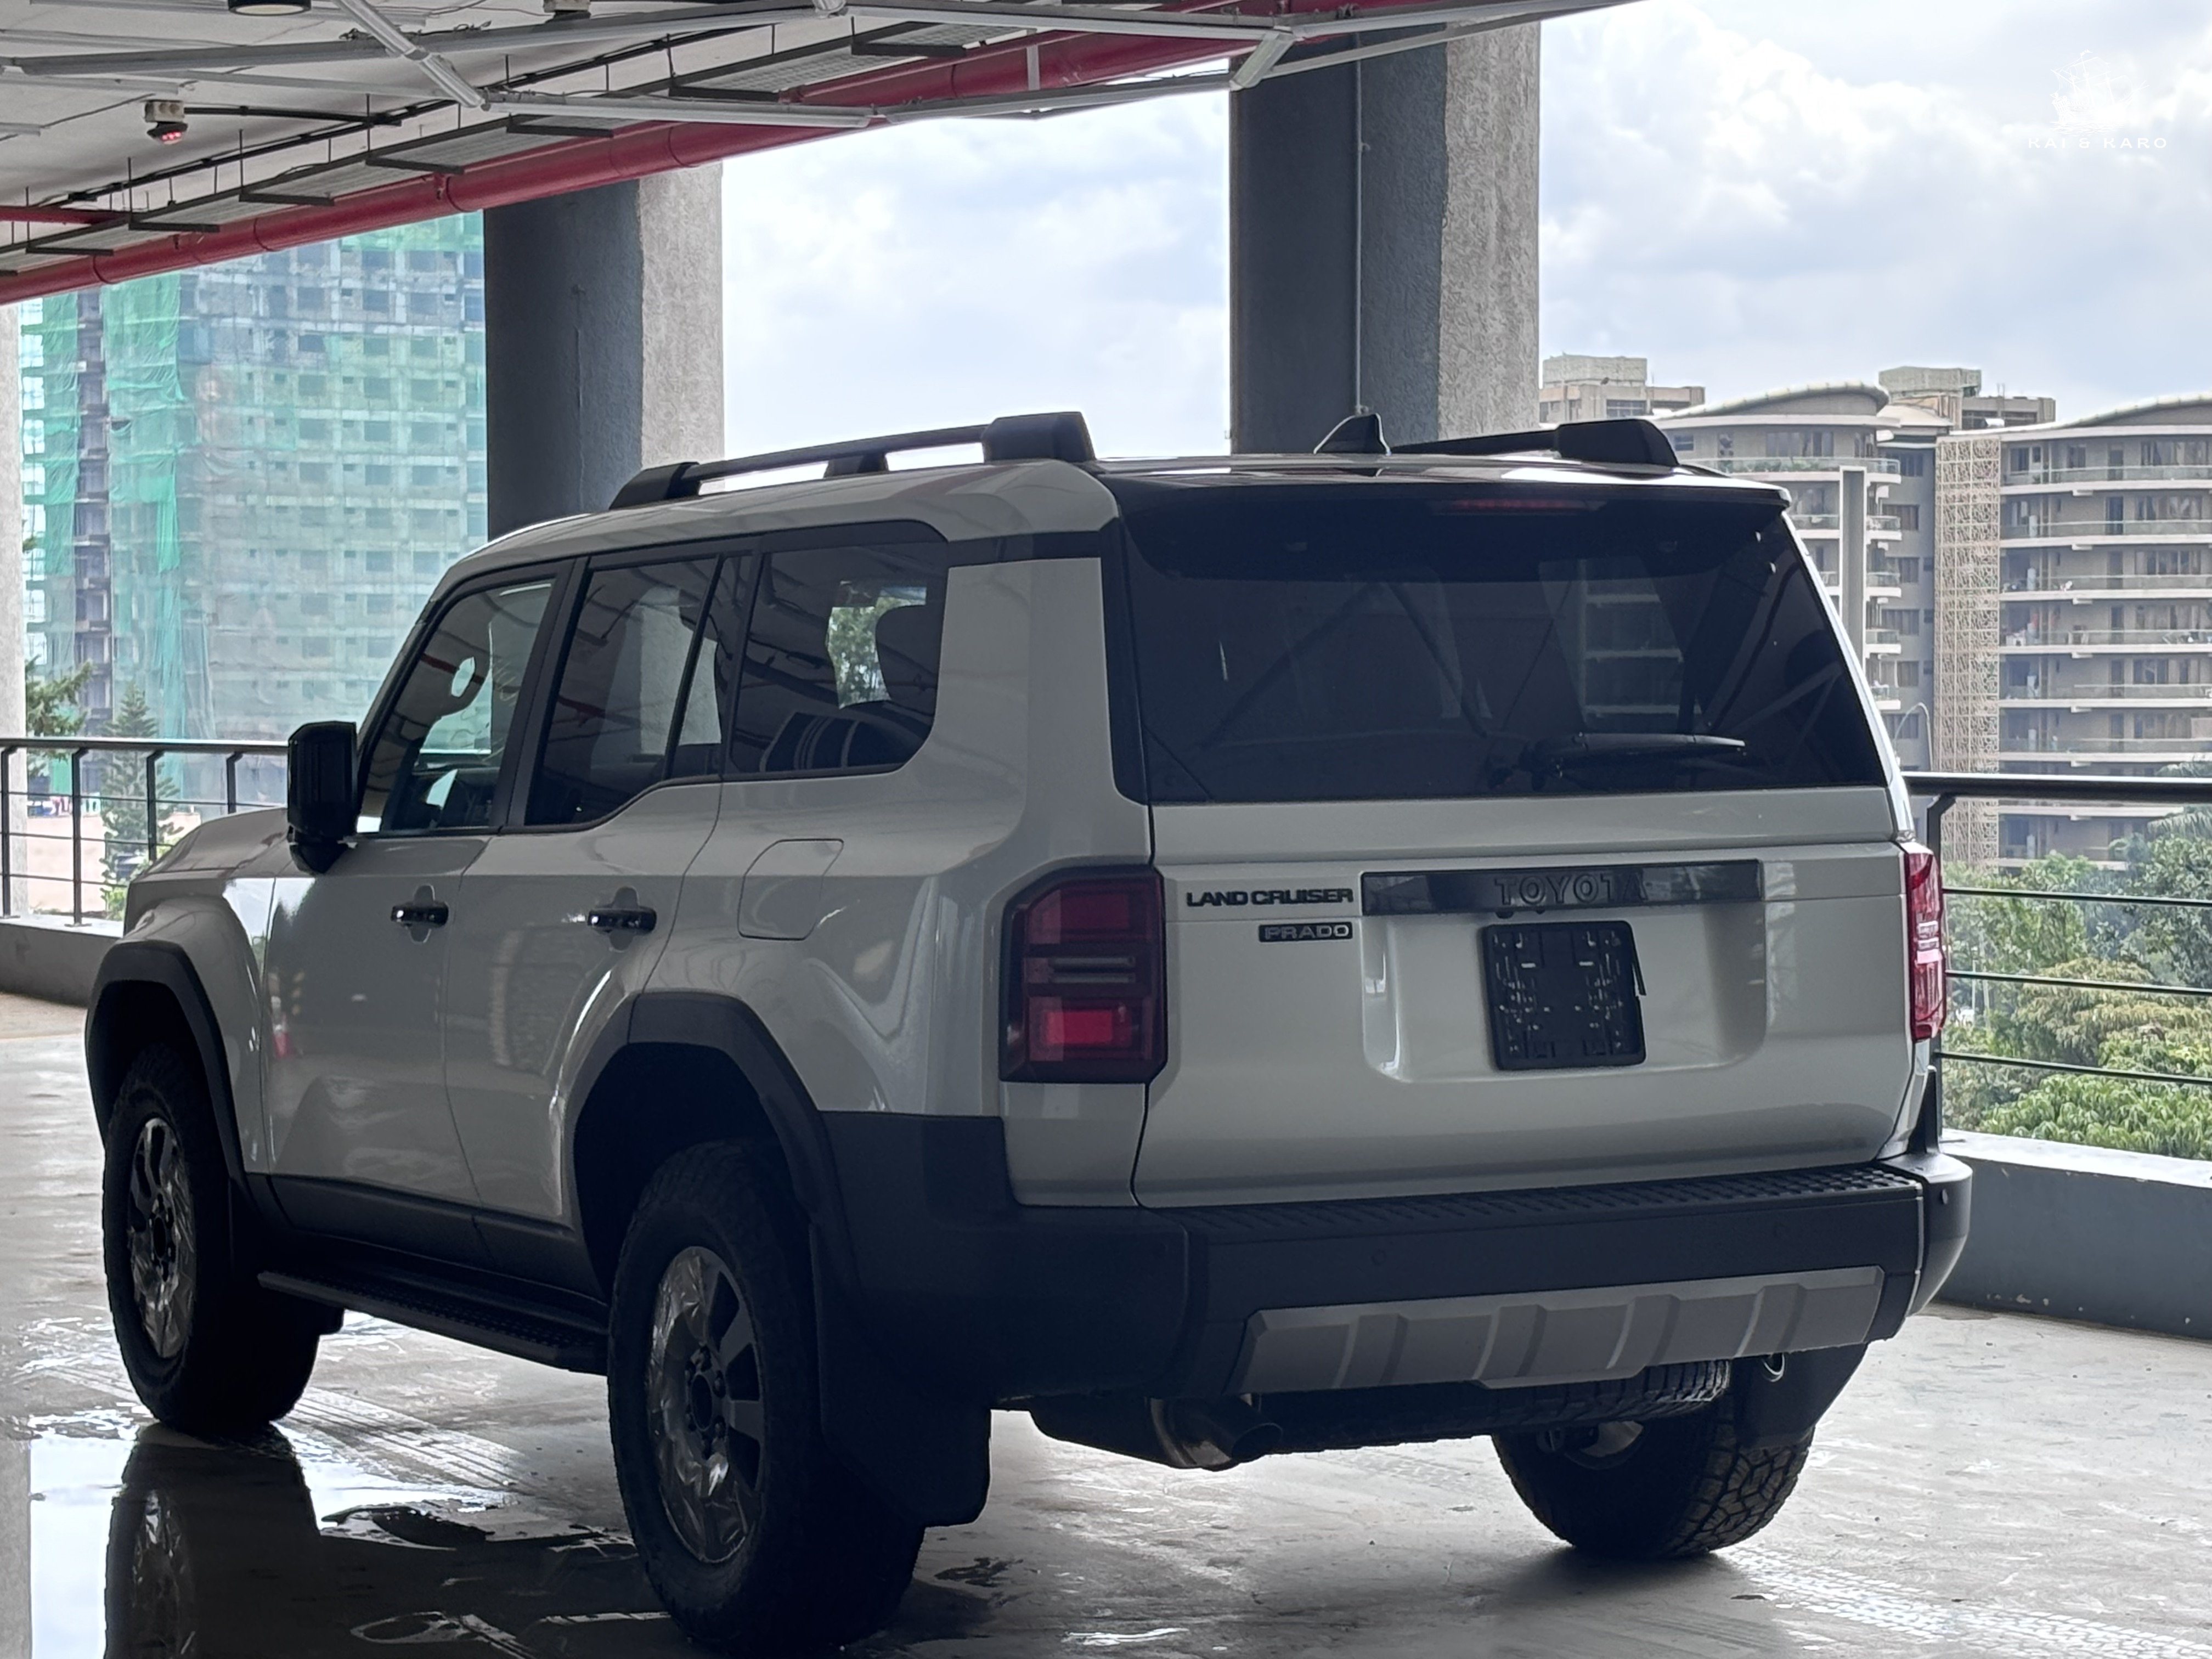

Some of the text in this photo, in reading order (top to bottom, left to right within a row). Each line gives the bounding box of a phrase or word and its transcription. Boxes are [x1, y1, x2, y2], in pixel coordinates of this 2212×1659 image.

[1187, 888, 1353, 906] LAND CRUISER
[1264, 924, 1349, 940] PRADO
